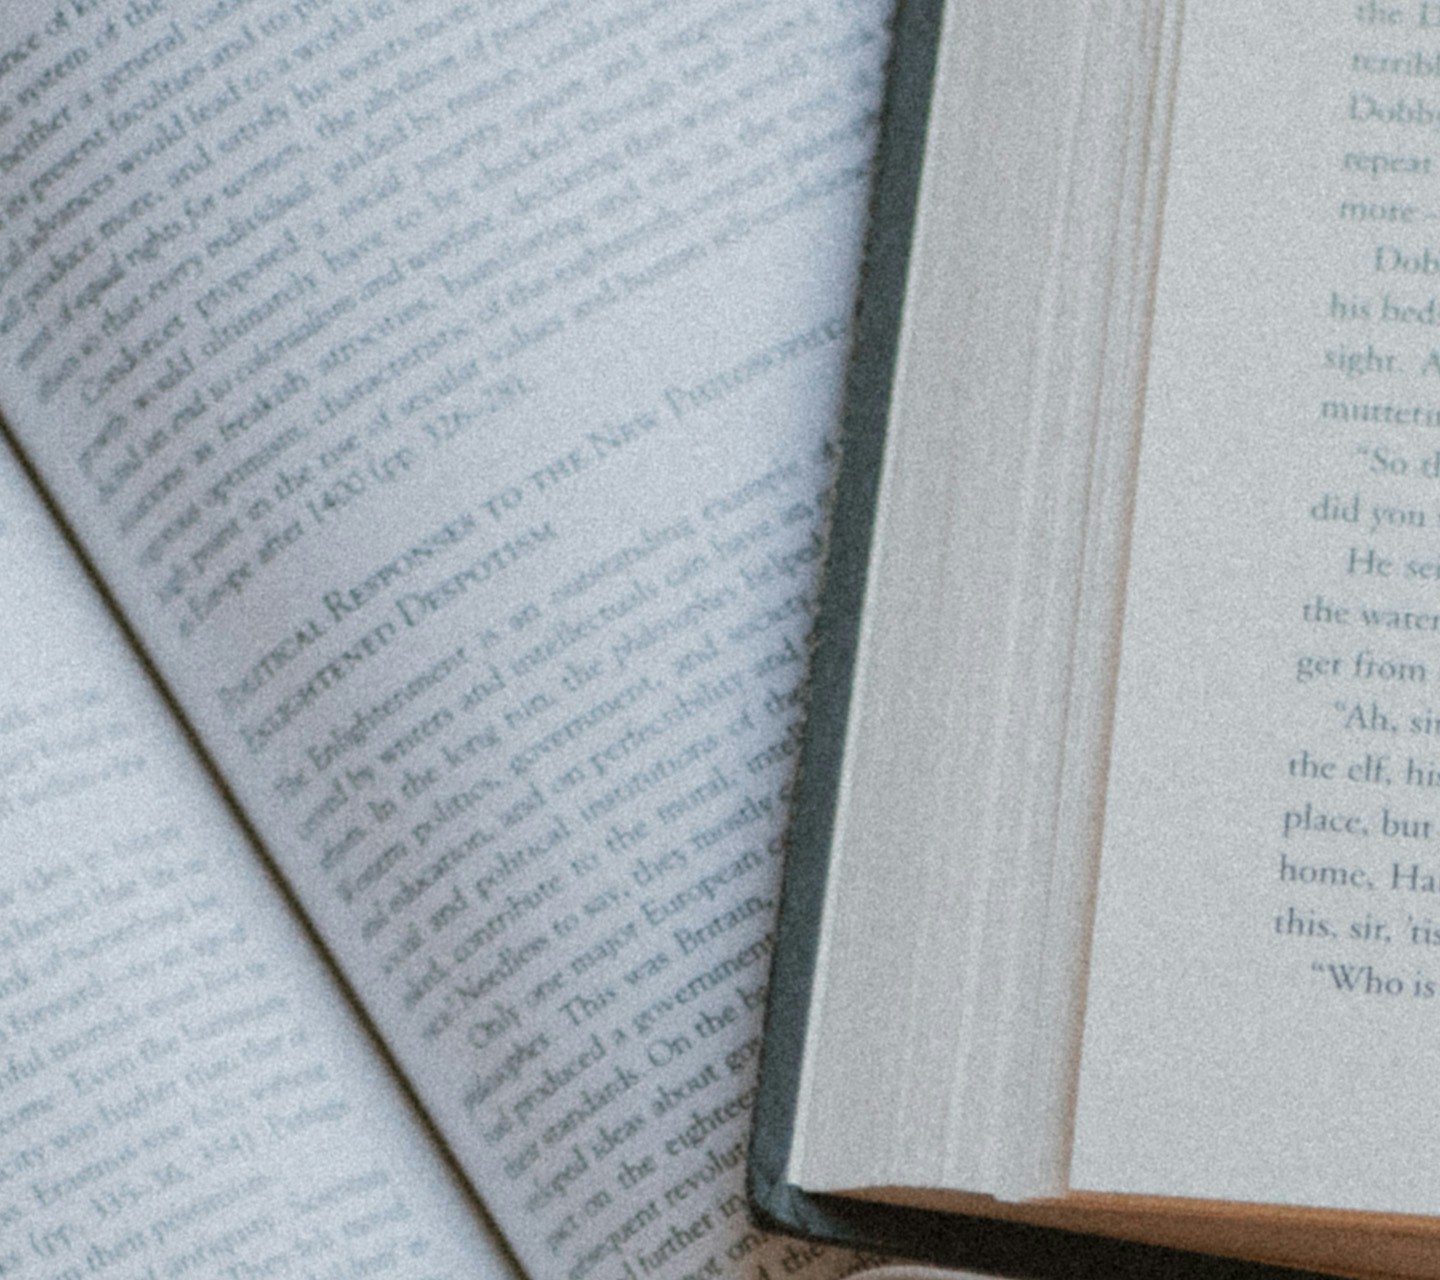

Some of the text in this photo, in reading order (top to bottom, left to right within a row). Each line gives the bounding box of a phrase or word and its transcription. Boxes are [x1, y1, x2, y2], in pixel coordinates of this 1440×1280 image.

[1272, 903, 1338, 939] this,
[1348, 911, 1392, 945] sir,
[1309, 960, 1406, 997] “Who
[1411, 977, 1437, 999] is
